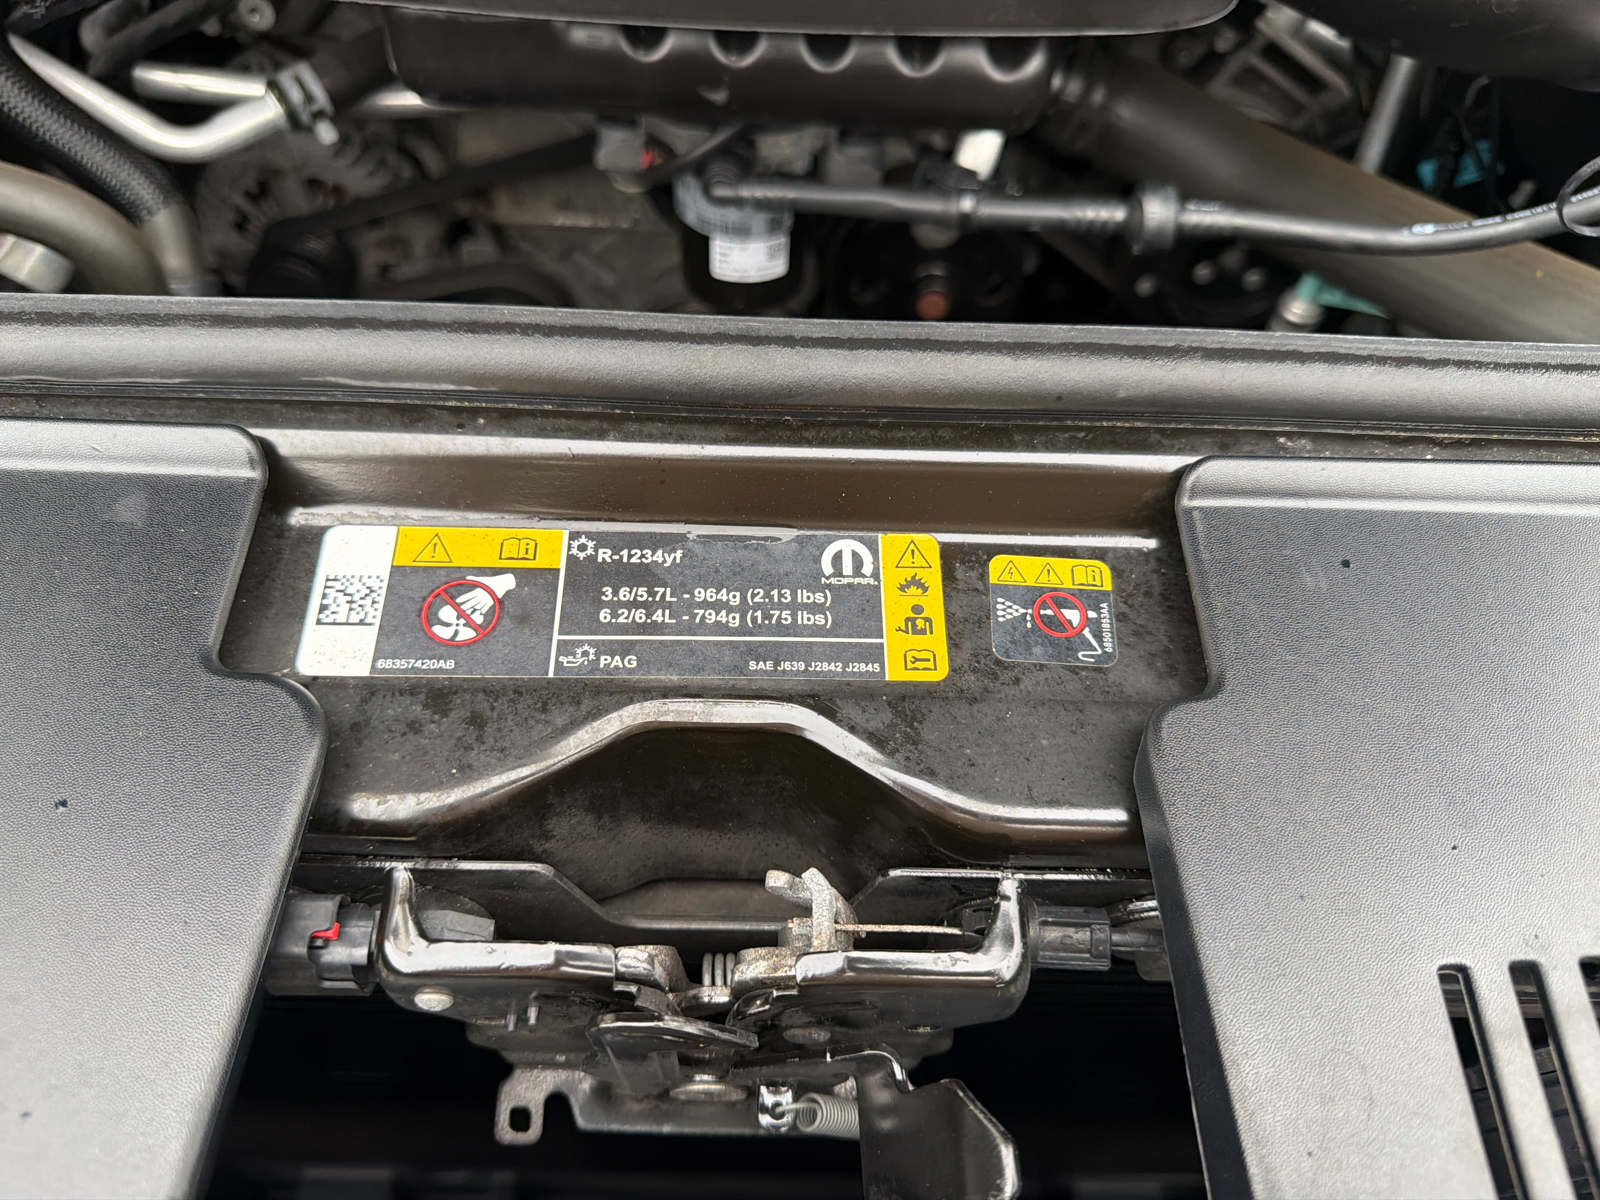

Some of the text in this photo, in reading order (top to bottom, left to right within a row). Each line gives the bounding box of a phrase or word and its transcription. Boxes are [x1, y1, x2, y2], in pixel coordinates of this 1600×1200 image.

[597, 548, 684, 567] R-1234yf
[601, 587, 678, 602] 3.6/5.7L
[694, 588, 740, 606] 964g
[747, 588, 791, 606] (2.13
[797, 589, 831, 607] lbs)
[599, 608, 677, 624] 6.2/6.4L
[693, 609, 740, 628] 794g
[746, 609, 792, 628] (1.75
[797, 610, 832, 629] lbs)
[1099, 602, 1113, 652] 68501853AA
[377, 658, 456, 670] 68357420AB
[599, 655, 638, 669] PAG
[748, 660, 880, 673] SAE J639 J2842 J2845
